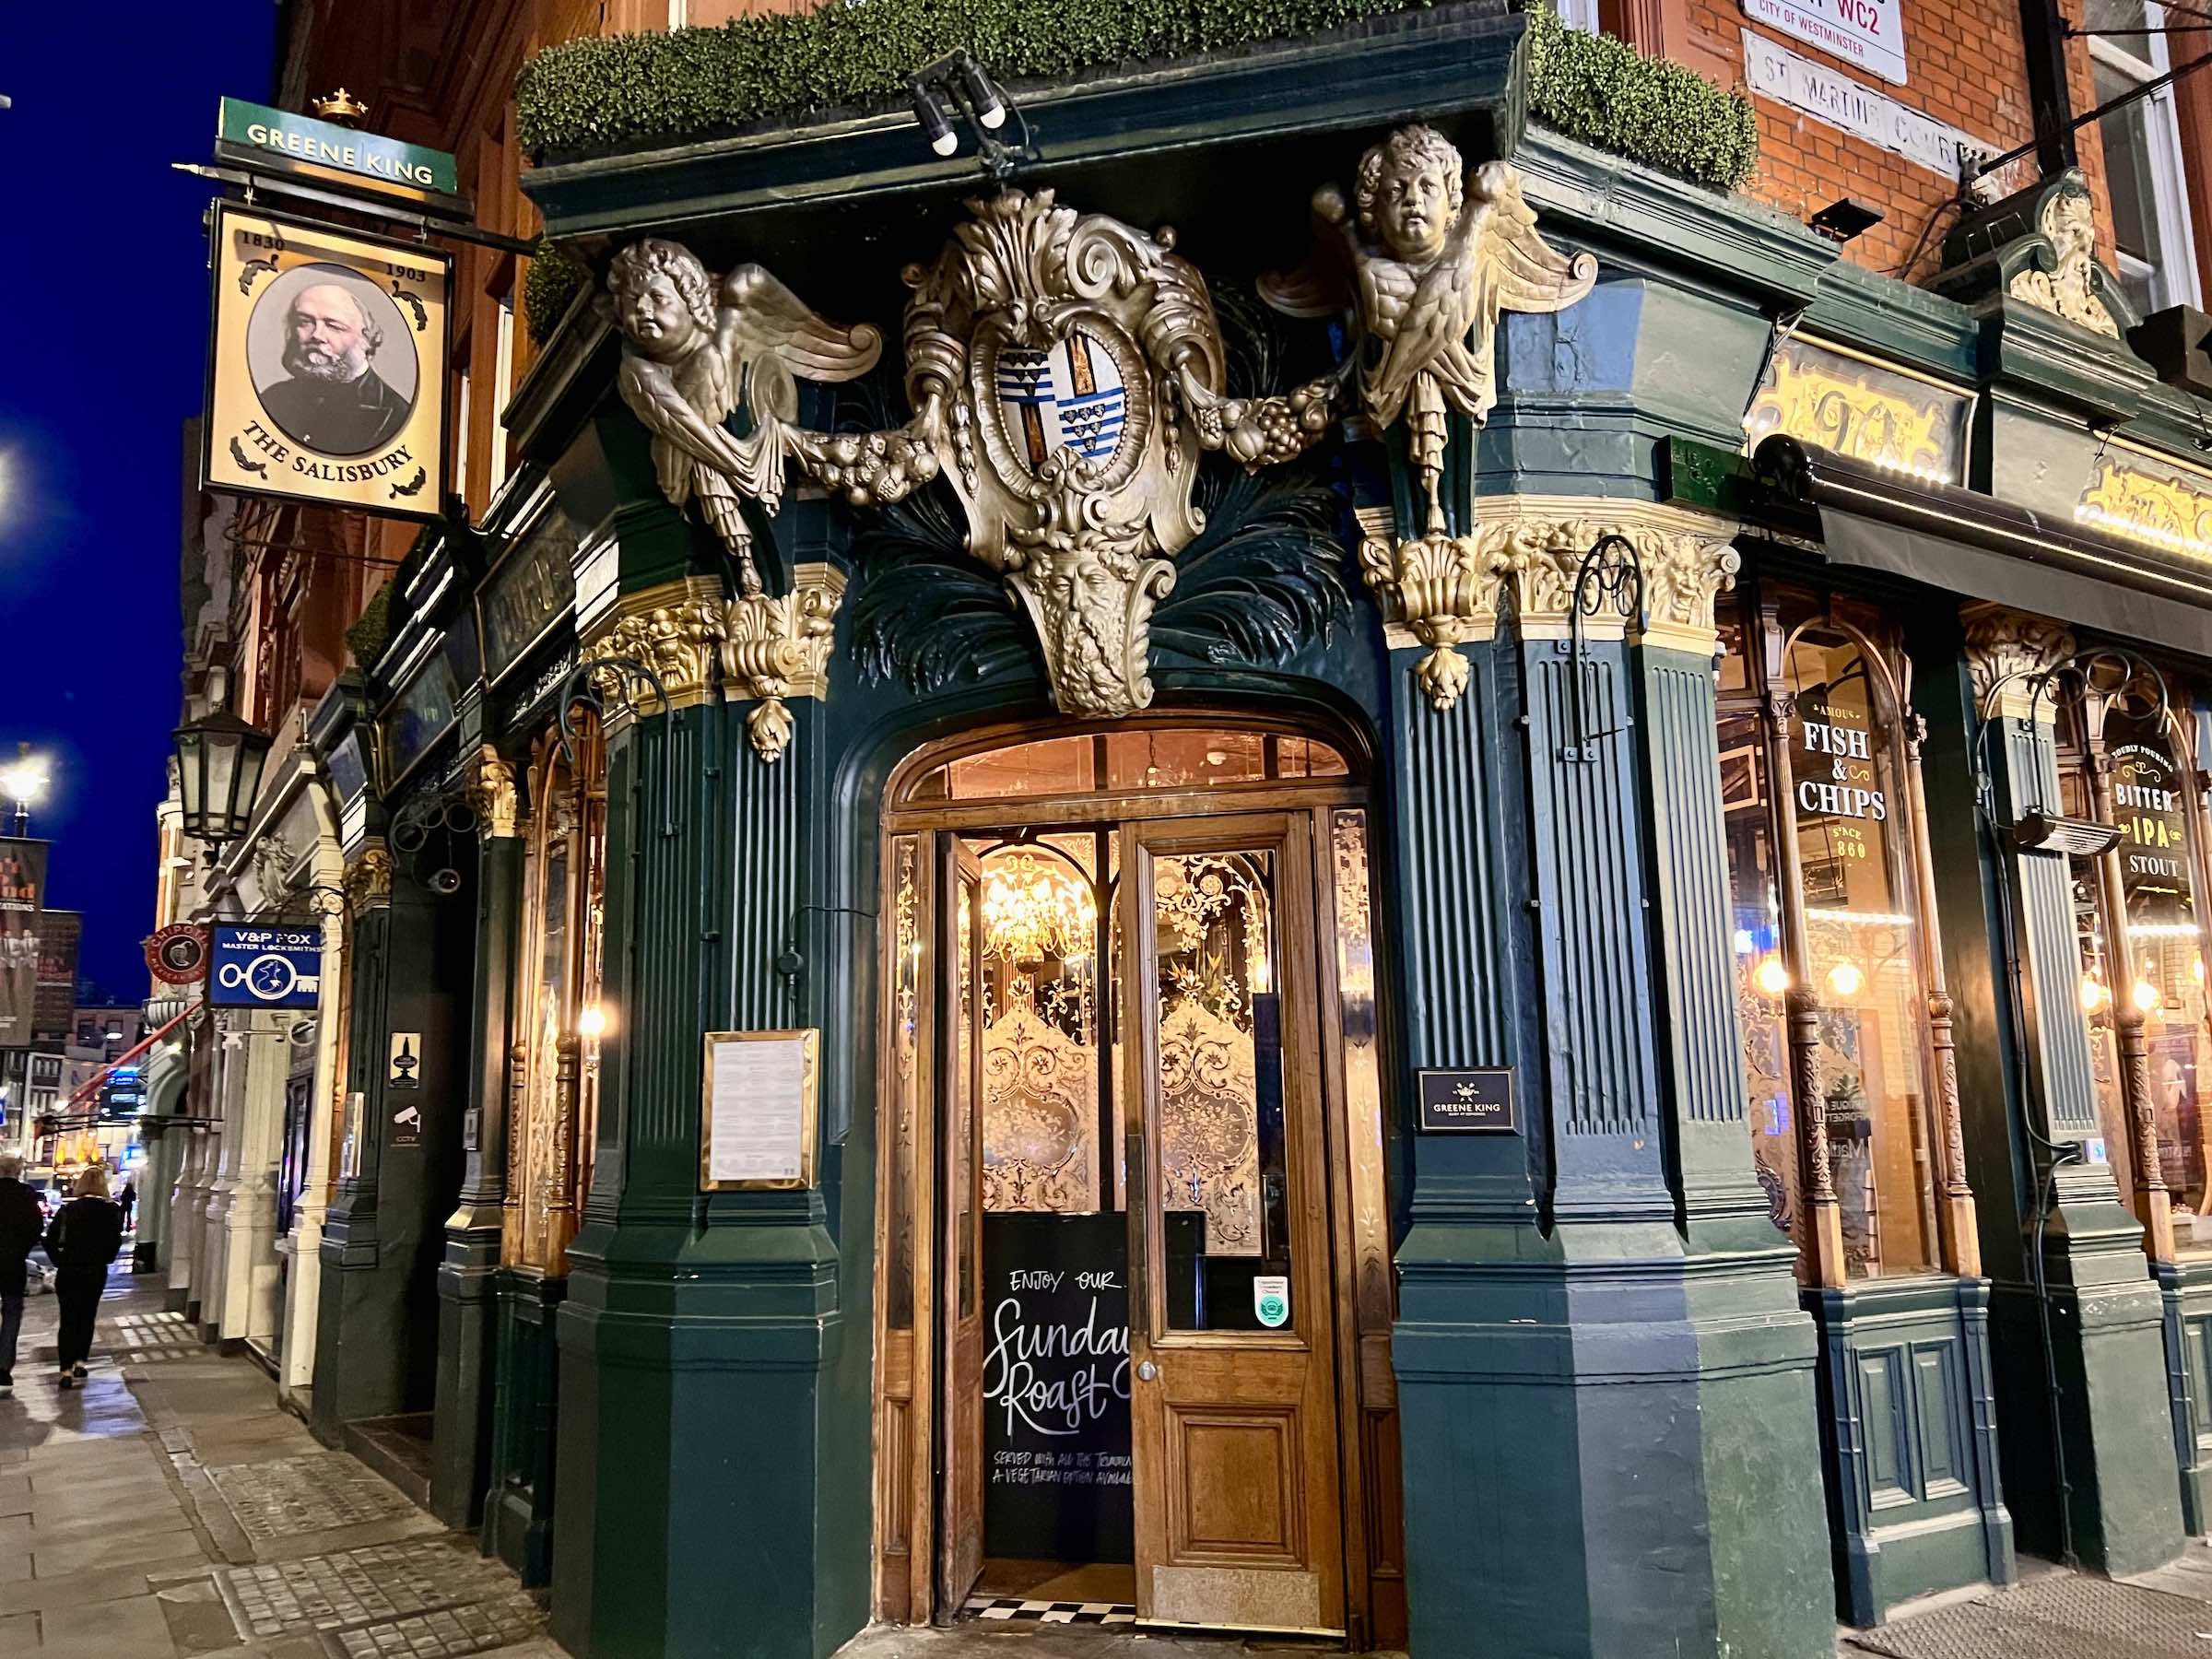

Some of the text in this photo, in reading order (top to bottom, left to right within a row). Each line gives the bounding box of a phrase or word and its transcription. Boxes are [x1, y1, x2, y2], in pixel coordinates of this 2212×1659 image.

[1759, 0, 1864, 57] CITY OF WESTMINSTER
[1837, 0, 1880, 35] WC2
[247, 124, 433, 185] GREENE KING
[242, 230, 285, 252] 1830
[386, 263, 427, 282] 1903
[243, 420, 414, 482] THE SALISBURY
[1802, 721, 1871, 760] FISH
[1831, 758, 1848, 782] &
[2140, 746, 2173, 773] POURING
[1799, 781, 1887, 822] CHIPS
[2114, 783, 2173, 813] BITTER
[2132, 816, 2171, 849] IPA
[2129, 855, 2179, 877] STOUT
[222, 942, 324, 953] MASTER LOCKSMITHS
[235, 931, 273, 944] V&P
[1433, 1103, 1500, 1112] GREENE KING
[1009, 1269, 1065, 1292] ENJOY
[999, 1361, 1111, 1436] Roast
[994, 1451, 1032, 1465] SERVED
[1006, 1467, 1061, 1485] VEGETARIAN
